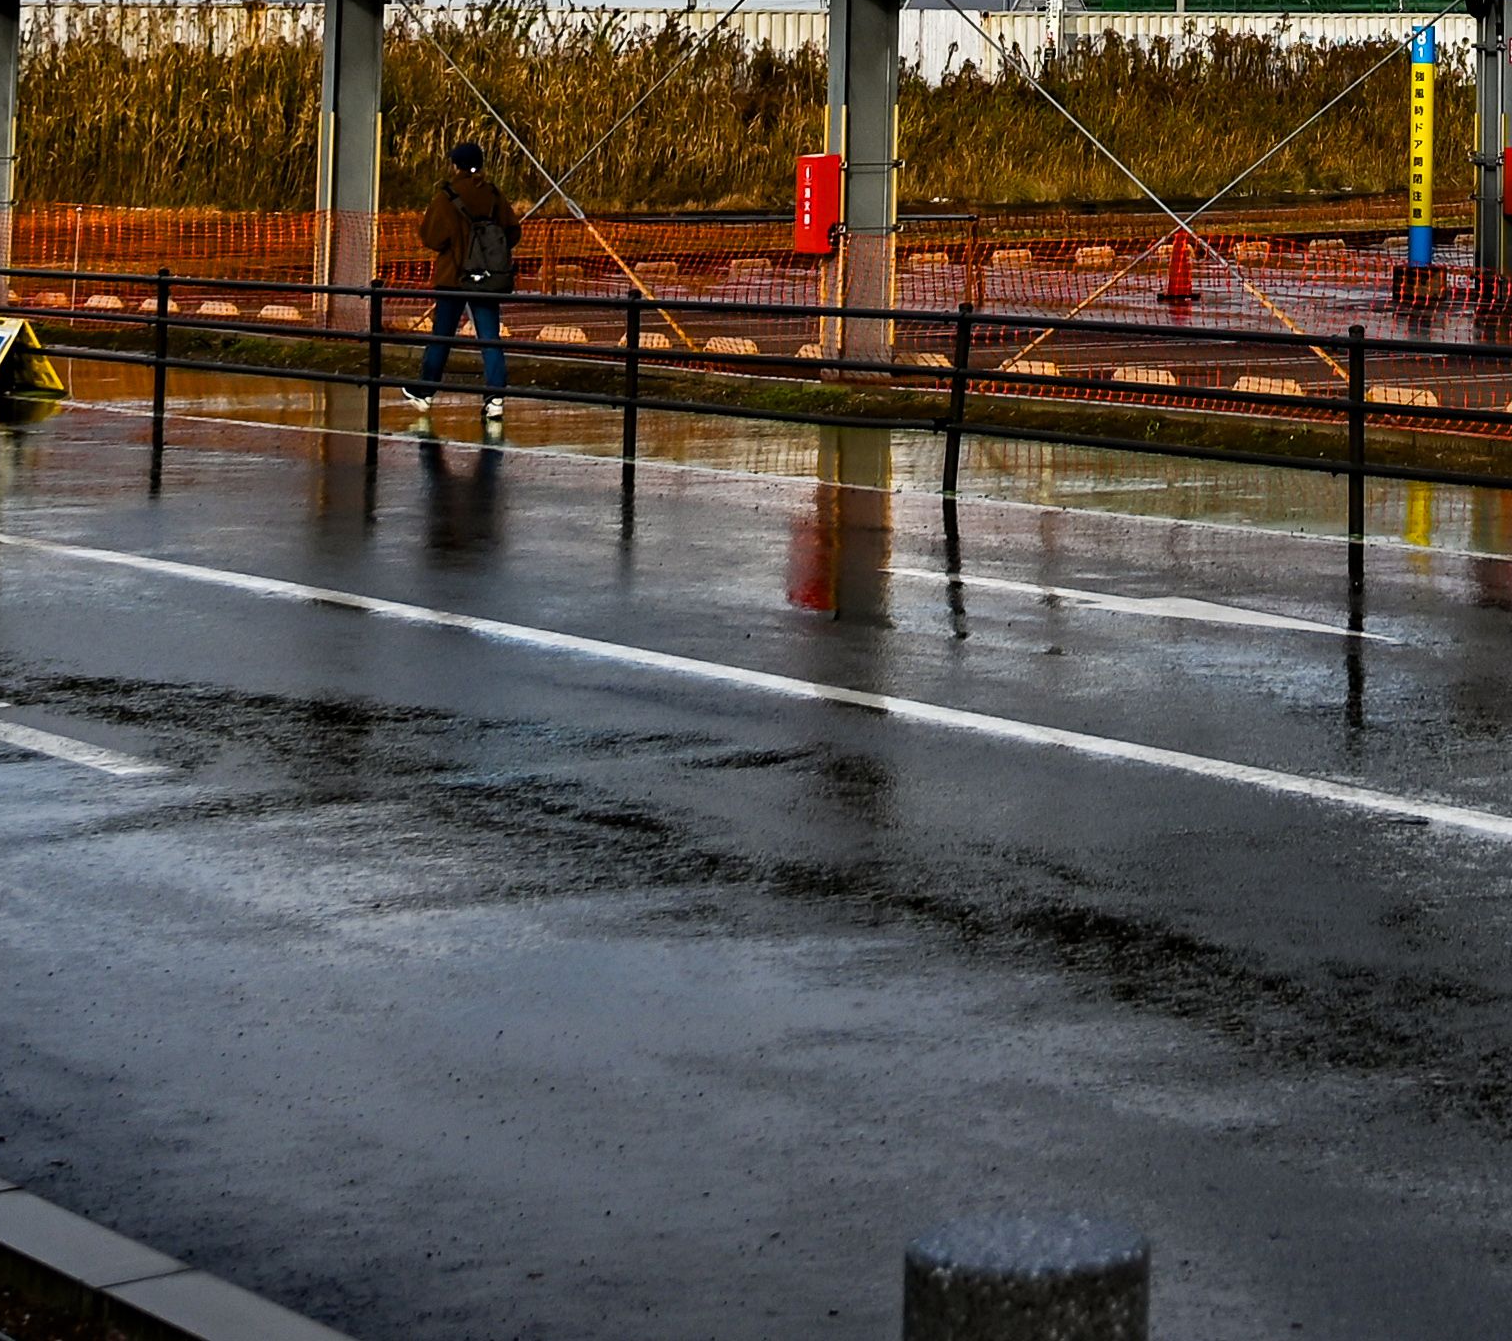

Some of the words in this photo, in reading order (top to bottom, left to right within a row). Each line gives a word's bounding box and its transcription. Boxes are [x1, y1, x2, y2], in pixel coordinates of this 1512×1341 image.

[1412, 71, 1425, 219] 強風時ドア開閉注意
